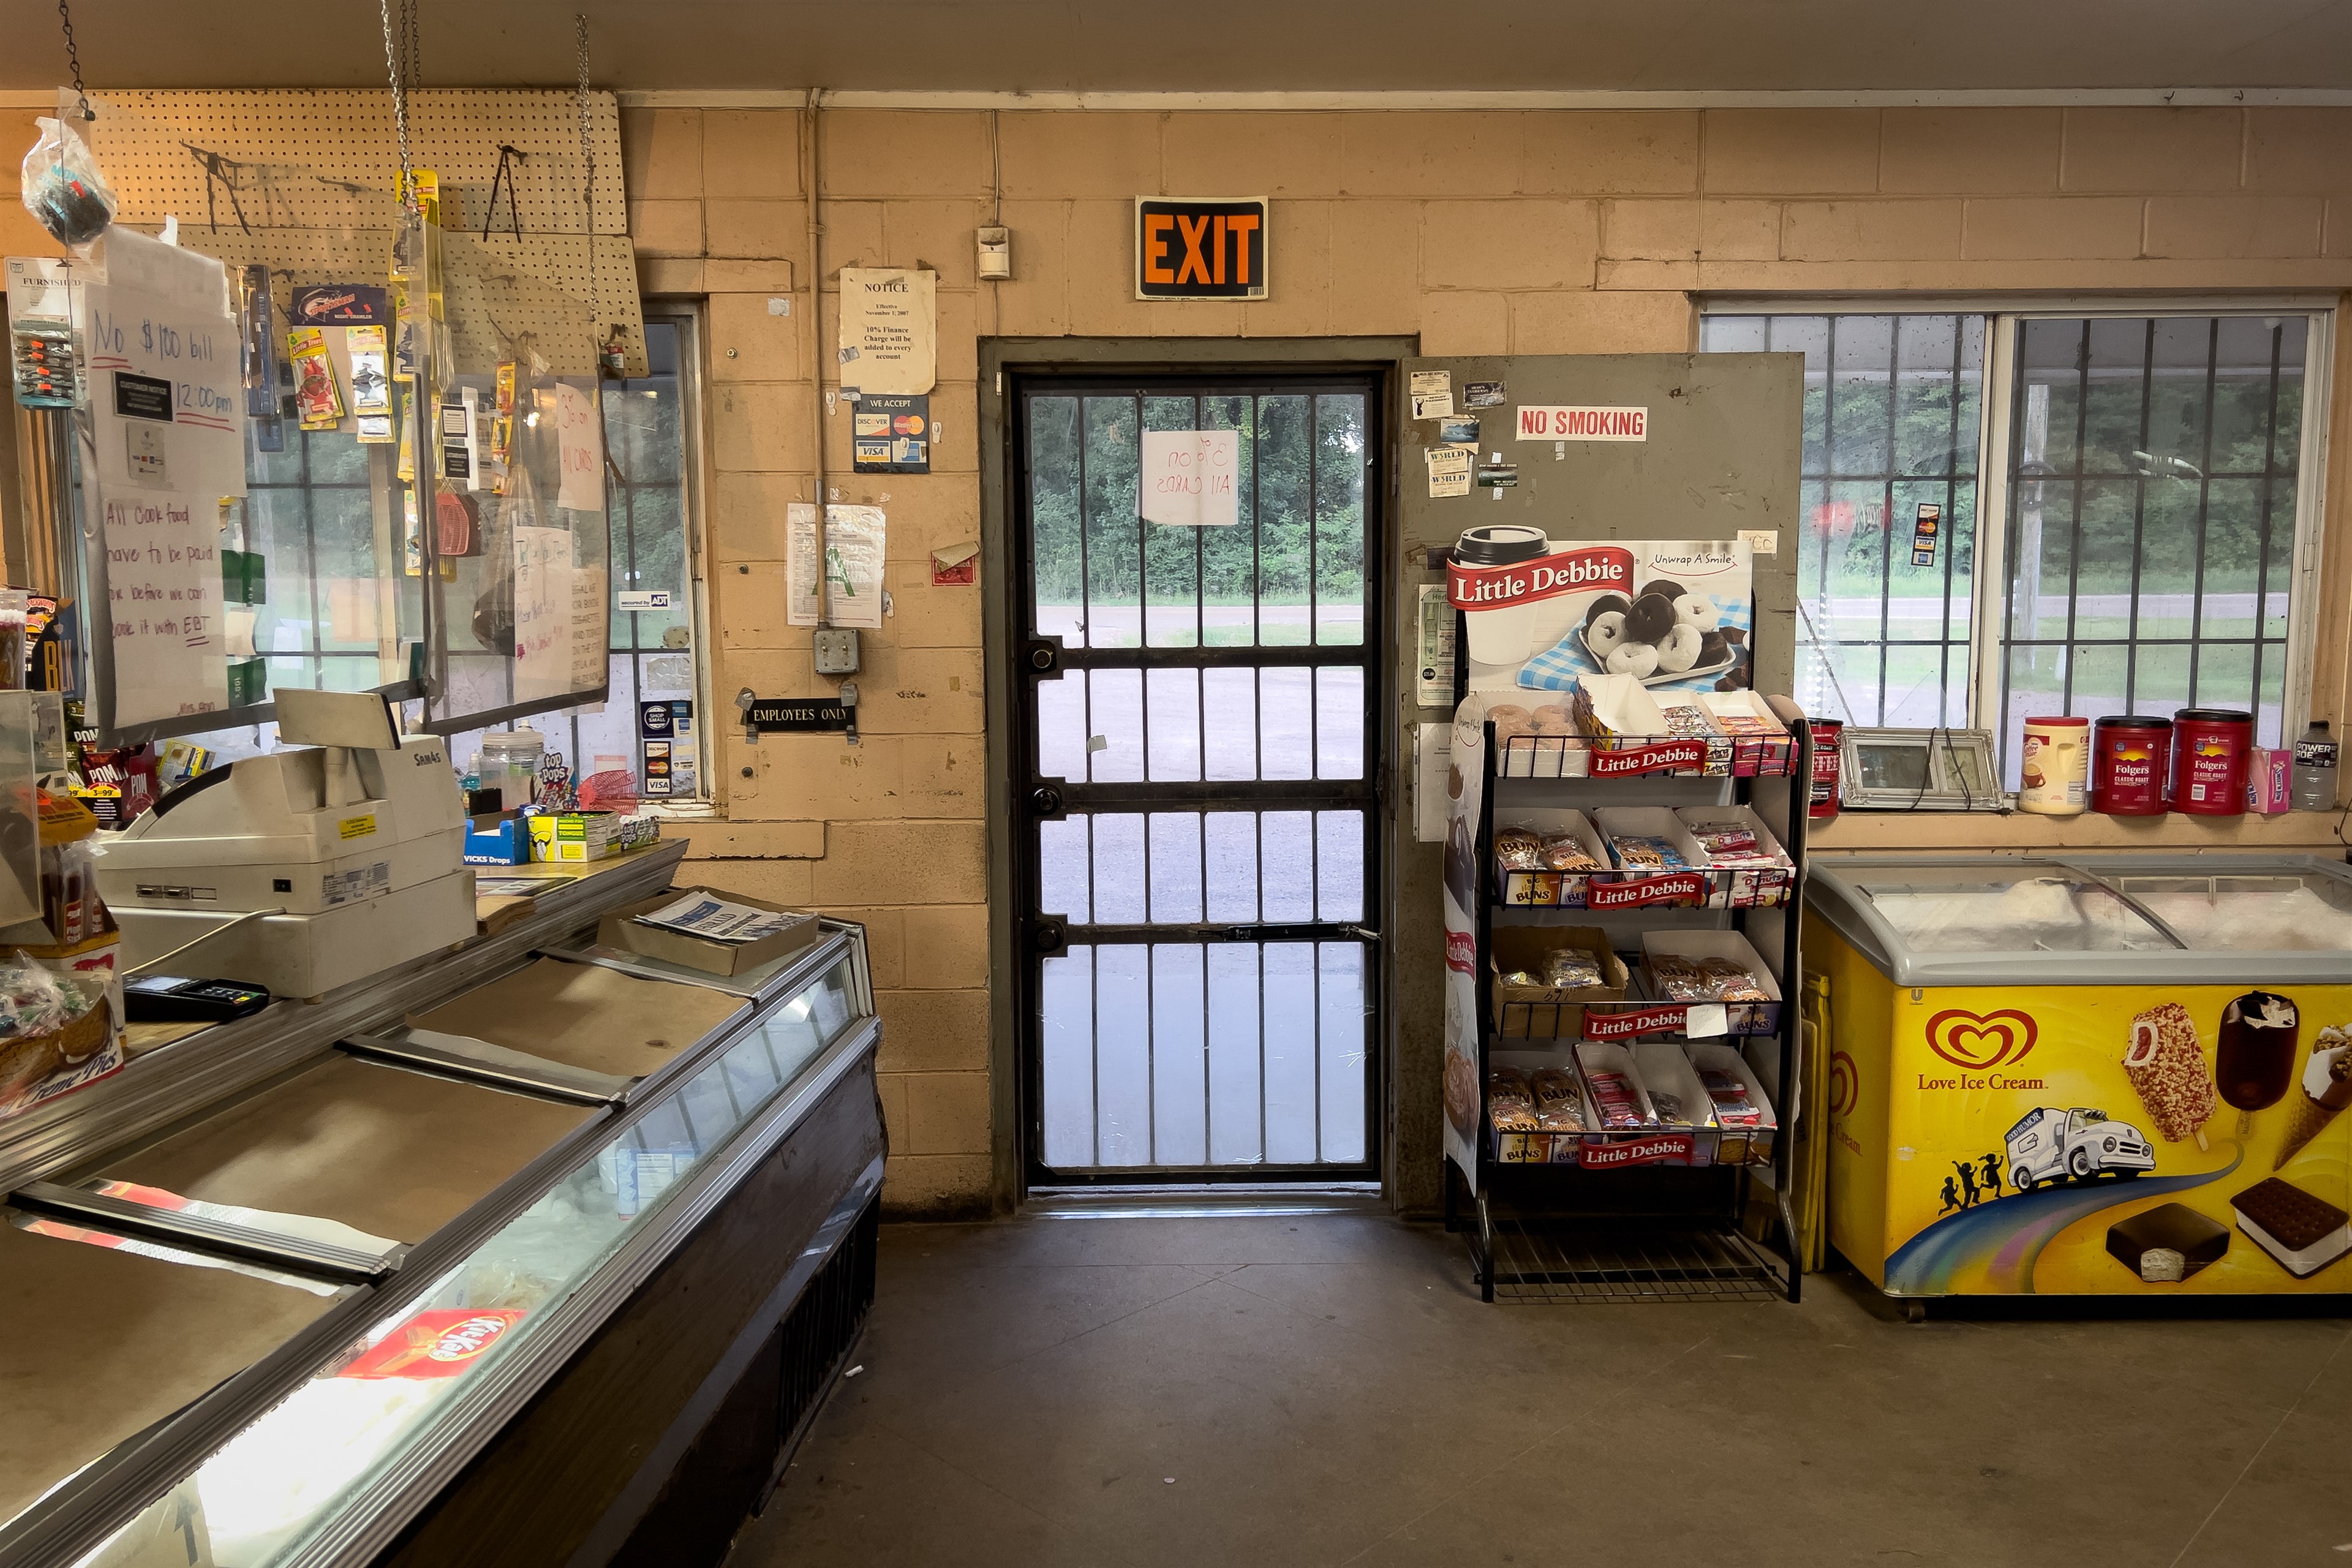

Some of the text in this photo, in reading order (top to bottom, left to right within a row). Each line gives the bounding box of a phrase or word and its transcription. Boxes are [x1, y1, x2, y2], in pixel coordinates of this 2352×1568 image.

[1145, 214, 1259, 284] EXIT
[23, 277, 81, 286] FURNISHED
[865, 283, 909, 293] NOTICE
[94, 308, 213, 361] No $100 bill
[864, 334, 889, 343] Charge
[292, 337, 323, 355] Little Trees
[884, 399, 911, 408] ACCEPT
[1521, 410, 1644, 436] NO SMOKING
[862, 447, 884, 456] VISA
[107, 502, 126, 526] All
[166, 502, 190, 525] food
[147, 541, 162, 564] to
[168, 543, 182, 563] be
[186, 545, 213, 567] paid
[1654, 552, 1732, 567] Unwrap A Smile
[1455, 557, 1623, 602] Little Debbie
[651, 596, 668, 606] ADT
[183, 616, 211, 635] EBT
[2297, 742, 2331, 753] POWER
[545, 752, 563, 768] top
[1596, 748, 1698, 772] Little Debbie
[2195, 760, 2228, 772] Folgers
[89, 764, 116, 783] POM
[541, 767, 567, 785] pops
[2115, 764, 2150, 777] Folgers
[130, 772, 148, 797] POM
[1717, 831, 1752, 845] Donuts
[1499, 842, 1539, 856] BUN
[1559, 851, 1577, 859] BIG
[463, 855, 511, 865] VICKS Drops
[1744, 874, 1784, 887] Donuts
[1515, 890, 1551, 902] BUNS
[1594, 880, 1696, 904] Little Debbie
[1657, 968, 1700, 979] BUN
[1591, 1019, 1634, 1036] Little
[1735, 1020, 1771, 1033] BUNS
[1917, 1073, 2044, 1090] Love Ice Cream
[1540, 1088, 1579, 1103] BUN
[2017, 1112, 2042, 1133] HUMOR
[1506, 1149, 1541, 1161] BUNS
[1587, 1141, 1686, 1164] Little Debbie
